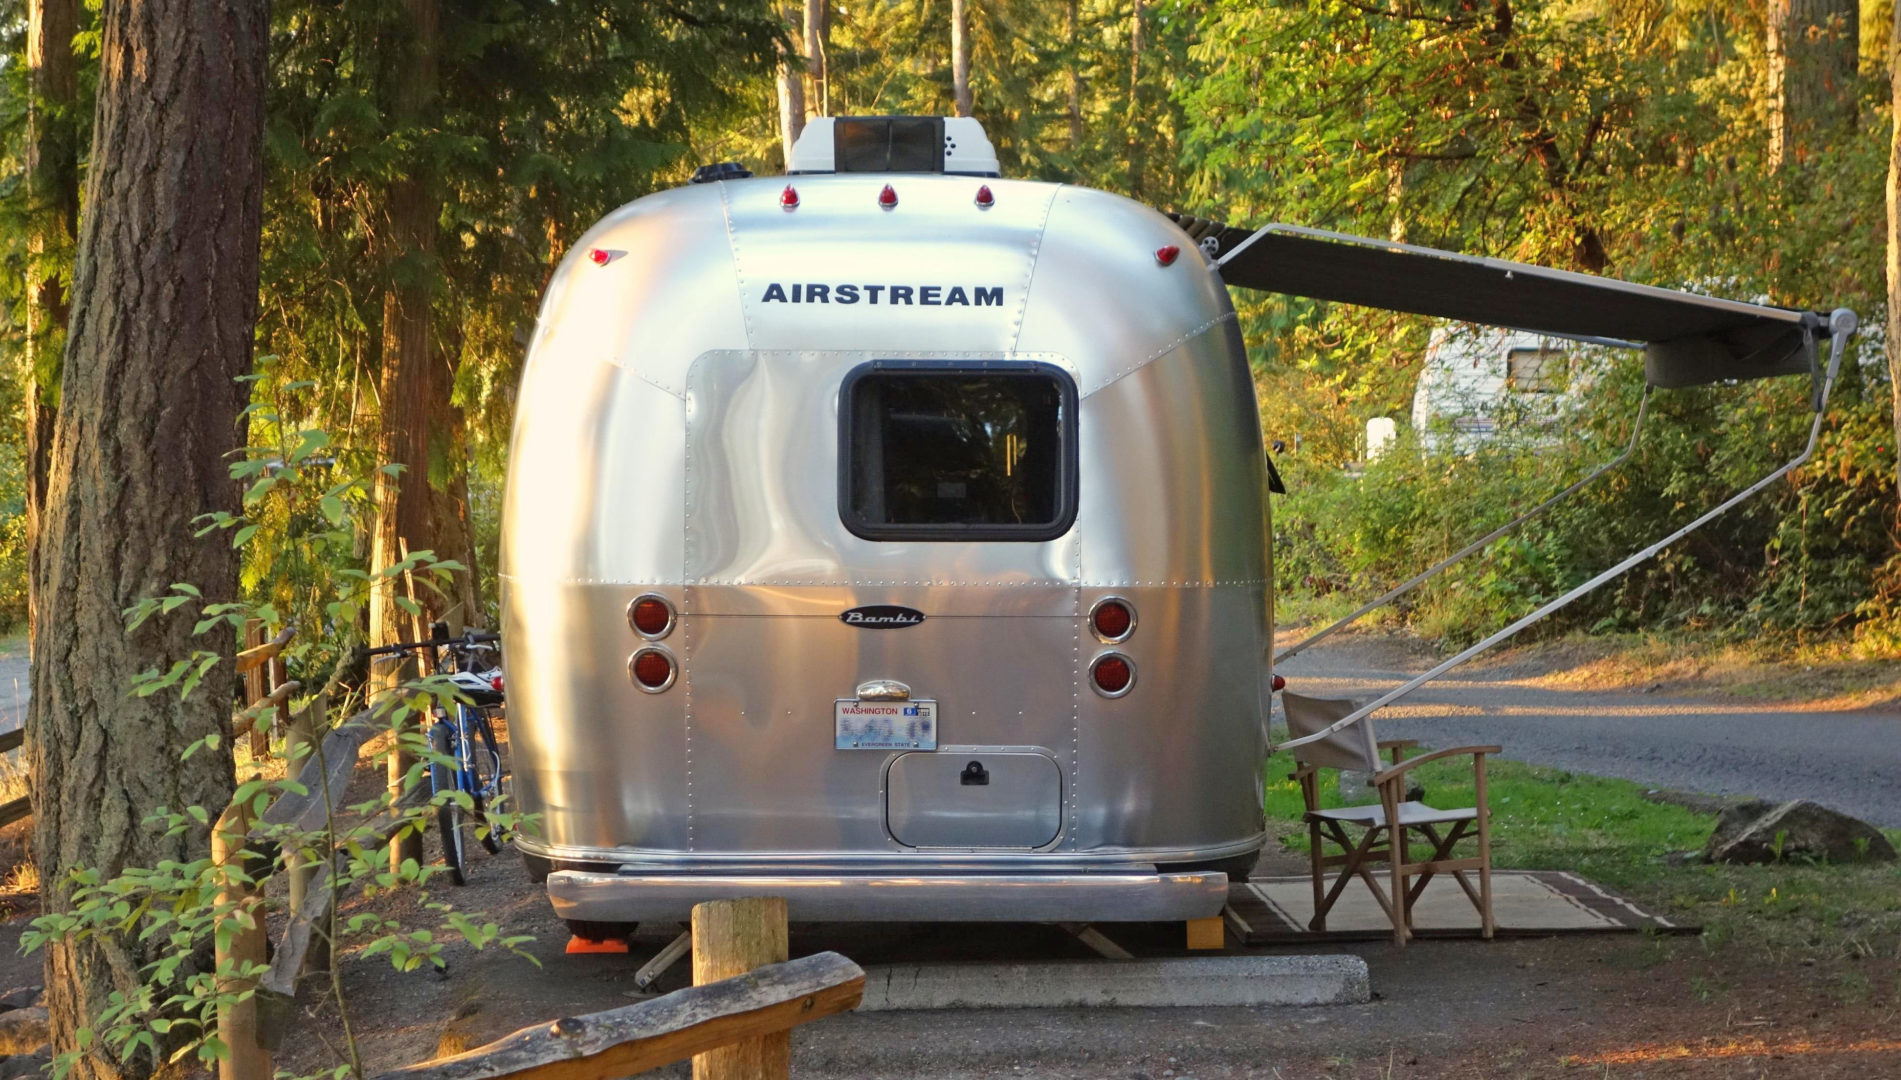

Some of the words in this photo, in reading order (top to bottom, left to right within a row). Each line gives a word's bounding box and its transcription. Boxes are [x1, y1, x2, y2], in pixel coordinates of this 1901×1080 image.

[761, 283, 1004, 306] AIRSTREAM
[846, 612, 920, 623] Bambi
[842, 707, 898, 715] WASHINGTON
